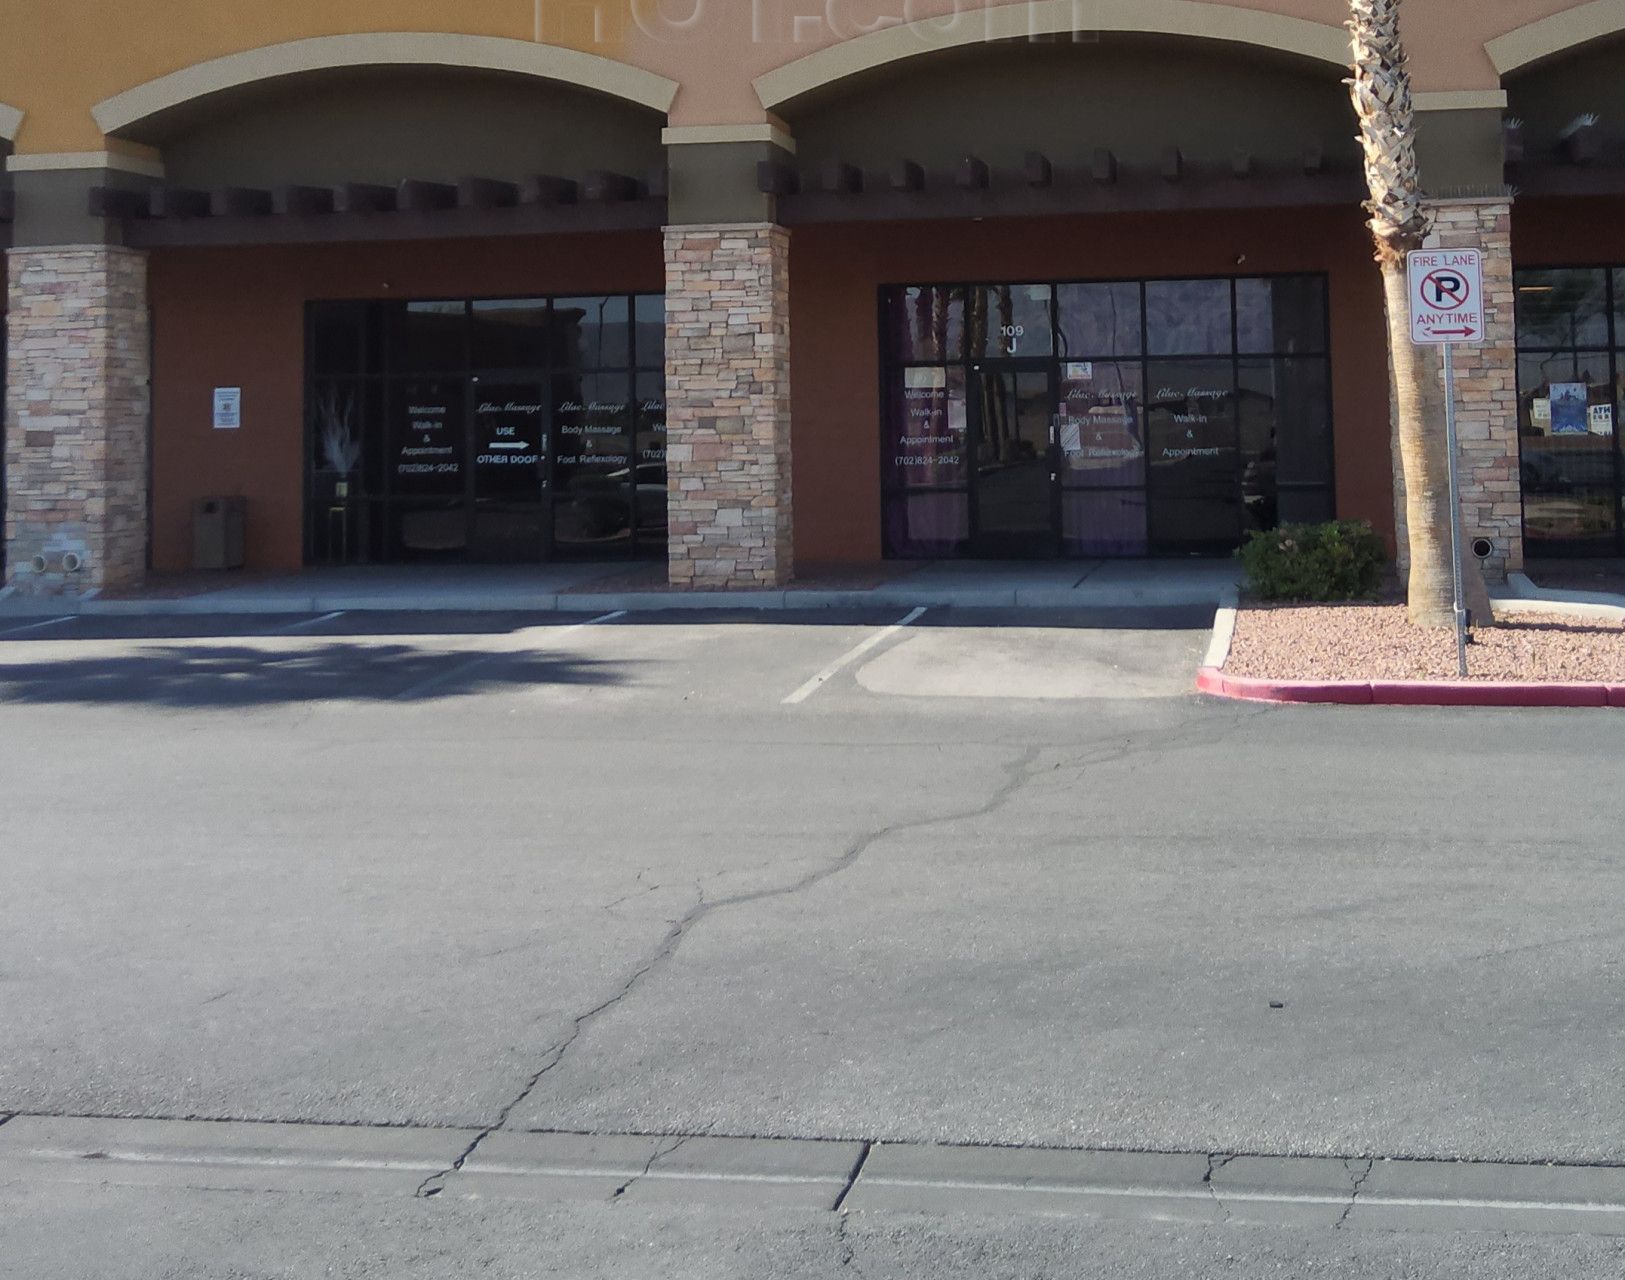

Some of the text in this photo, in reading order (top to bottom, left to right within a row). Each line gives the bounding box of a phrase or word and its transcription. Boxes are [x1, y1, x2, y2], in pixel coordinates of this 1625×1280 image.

[1413, 255, 1475, 266] FIRE LANE
[1417, 313, 1477, 324] ANYTIME
[1001, 326, 1023, 336] 109
[1007, 338, 1016, 353] J
[904, 390, 944, 398] Welcome
[1173, 413, 1207, 422] Walk-in
[496, 427, 515, 435] USE
[561, 425, 622, 435] Body Massage
[900, 435, 953, 445] Appointment
[1163, 447, 1219, 457] Appointment
